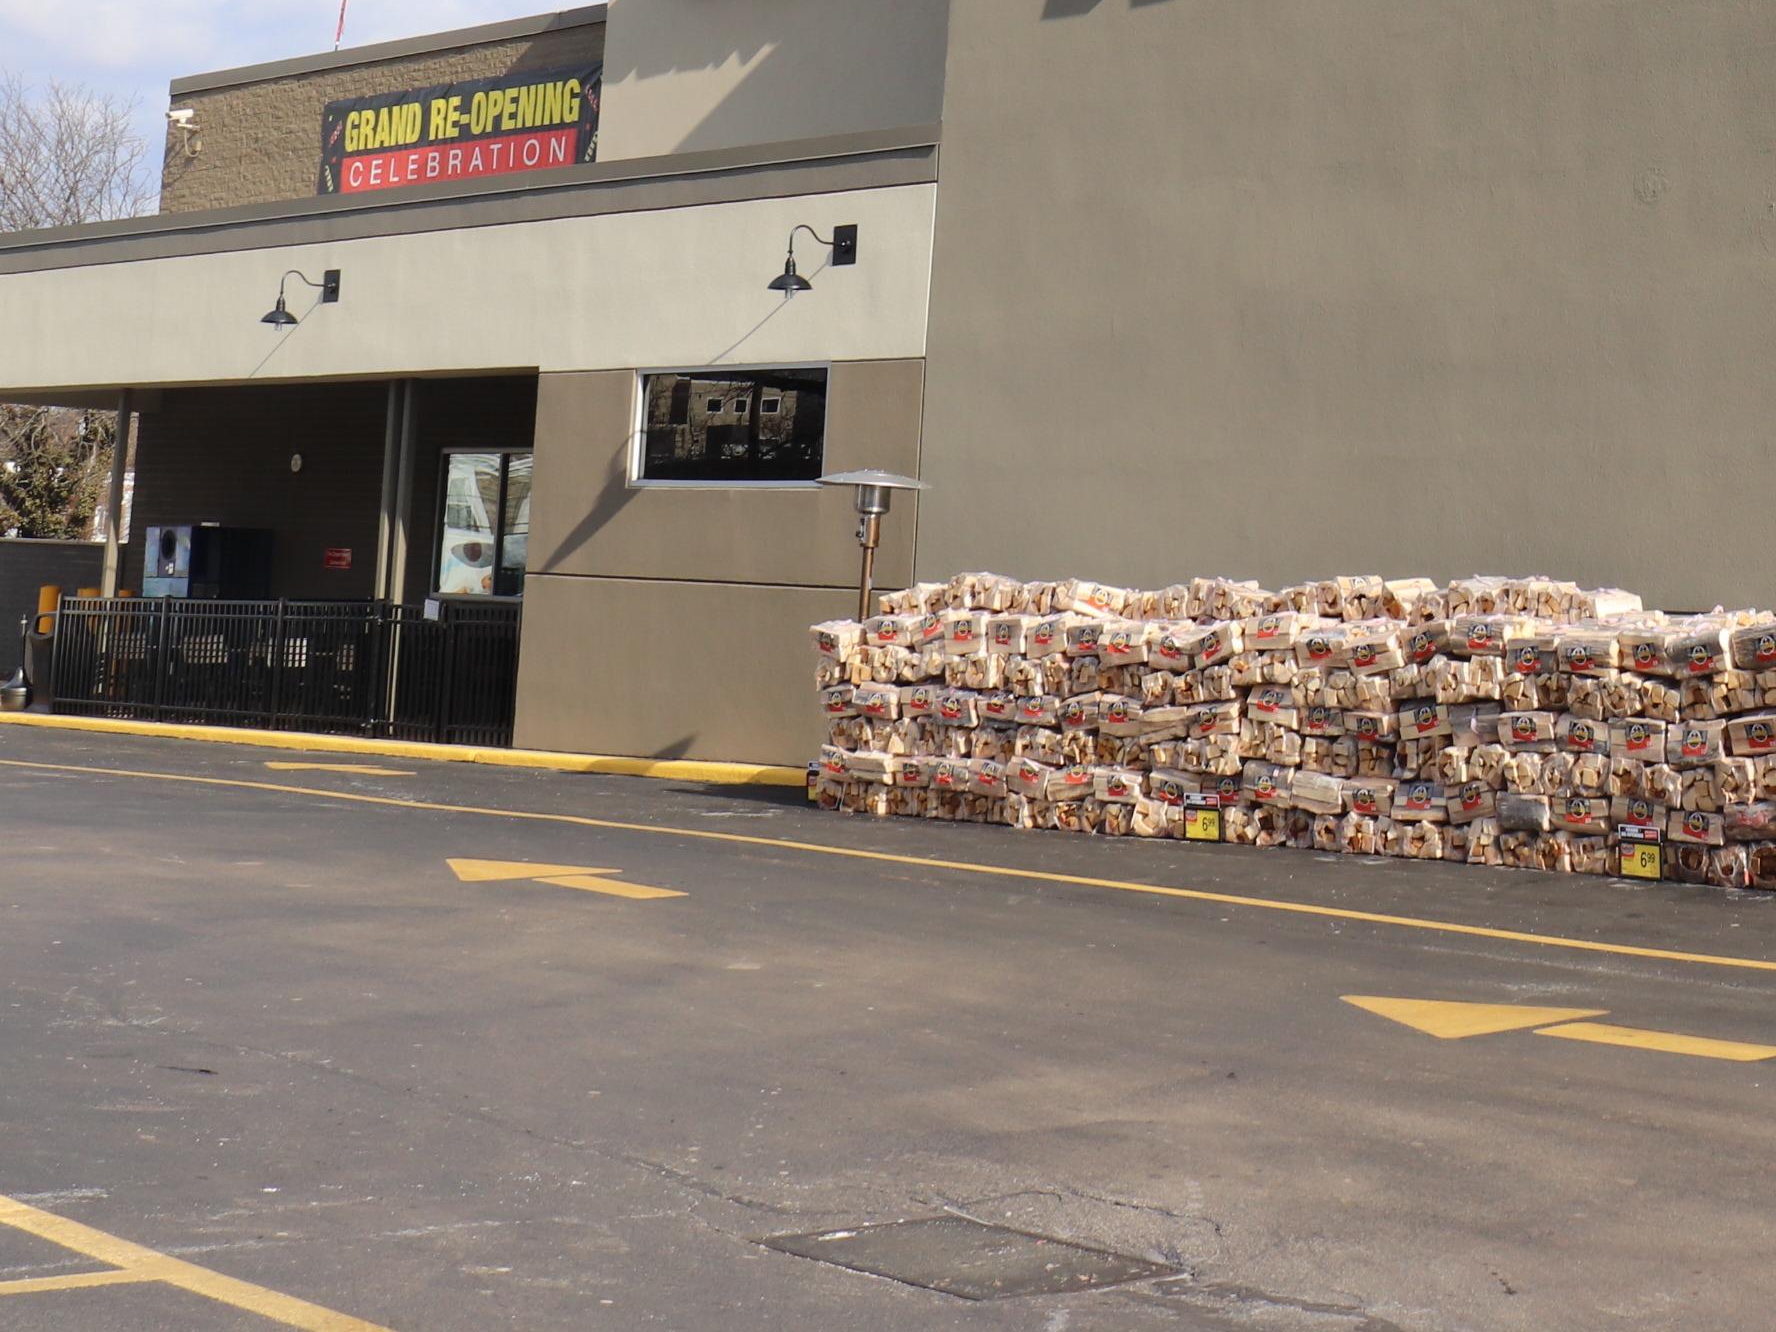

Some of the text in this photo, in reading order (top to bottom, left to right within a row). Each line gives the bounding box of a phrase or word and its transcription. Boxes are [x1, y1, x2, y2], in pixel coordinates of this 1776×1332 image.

[345, 78, 581, 152] GRAND RE-OPENING
[350, 136, 566, 187] CELEBRATION
